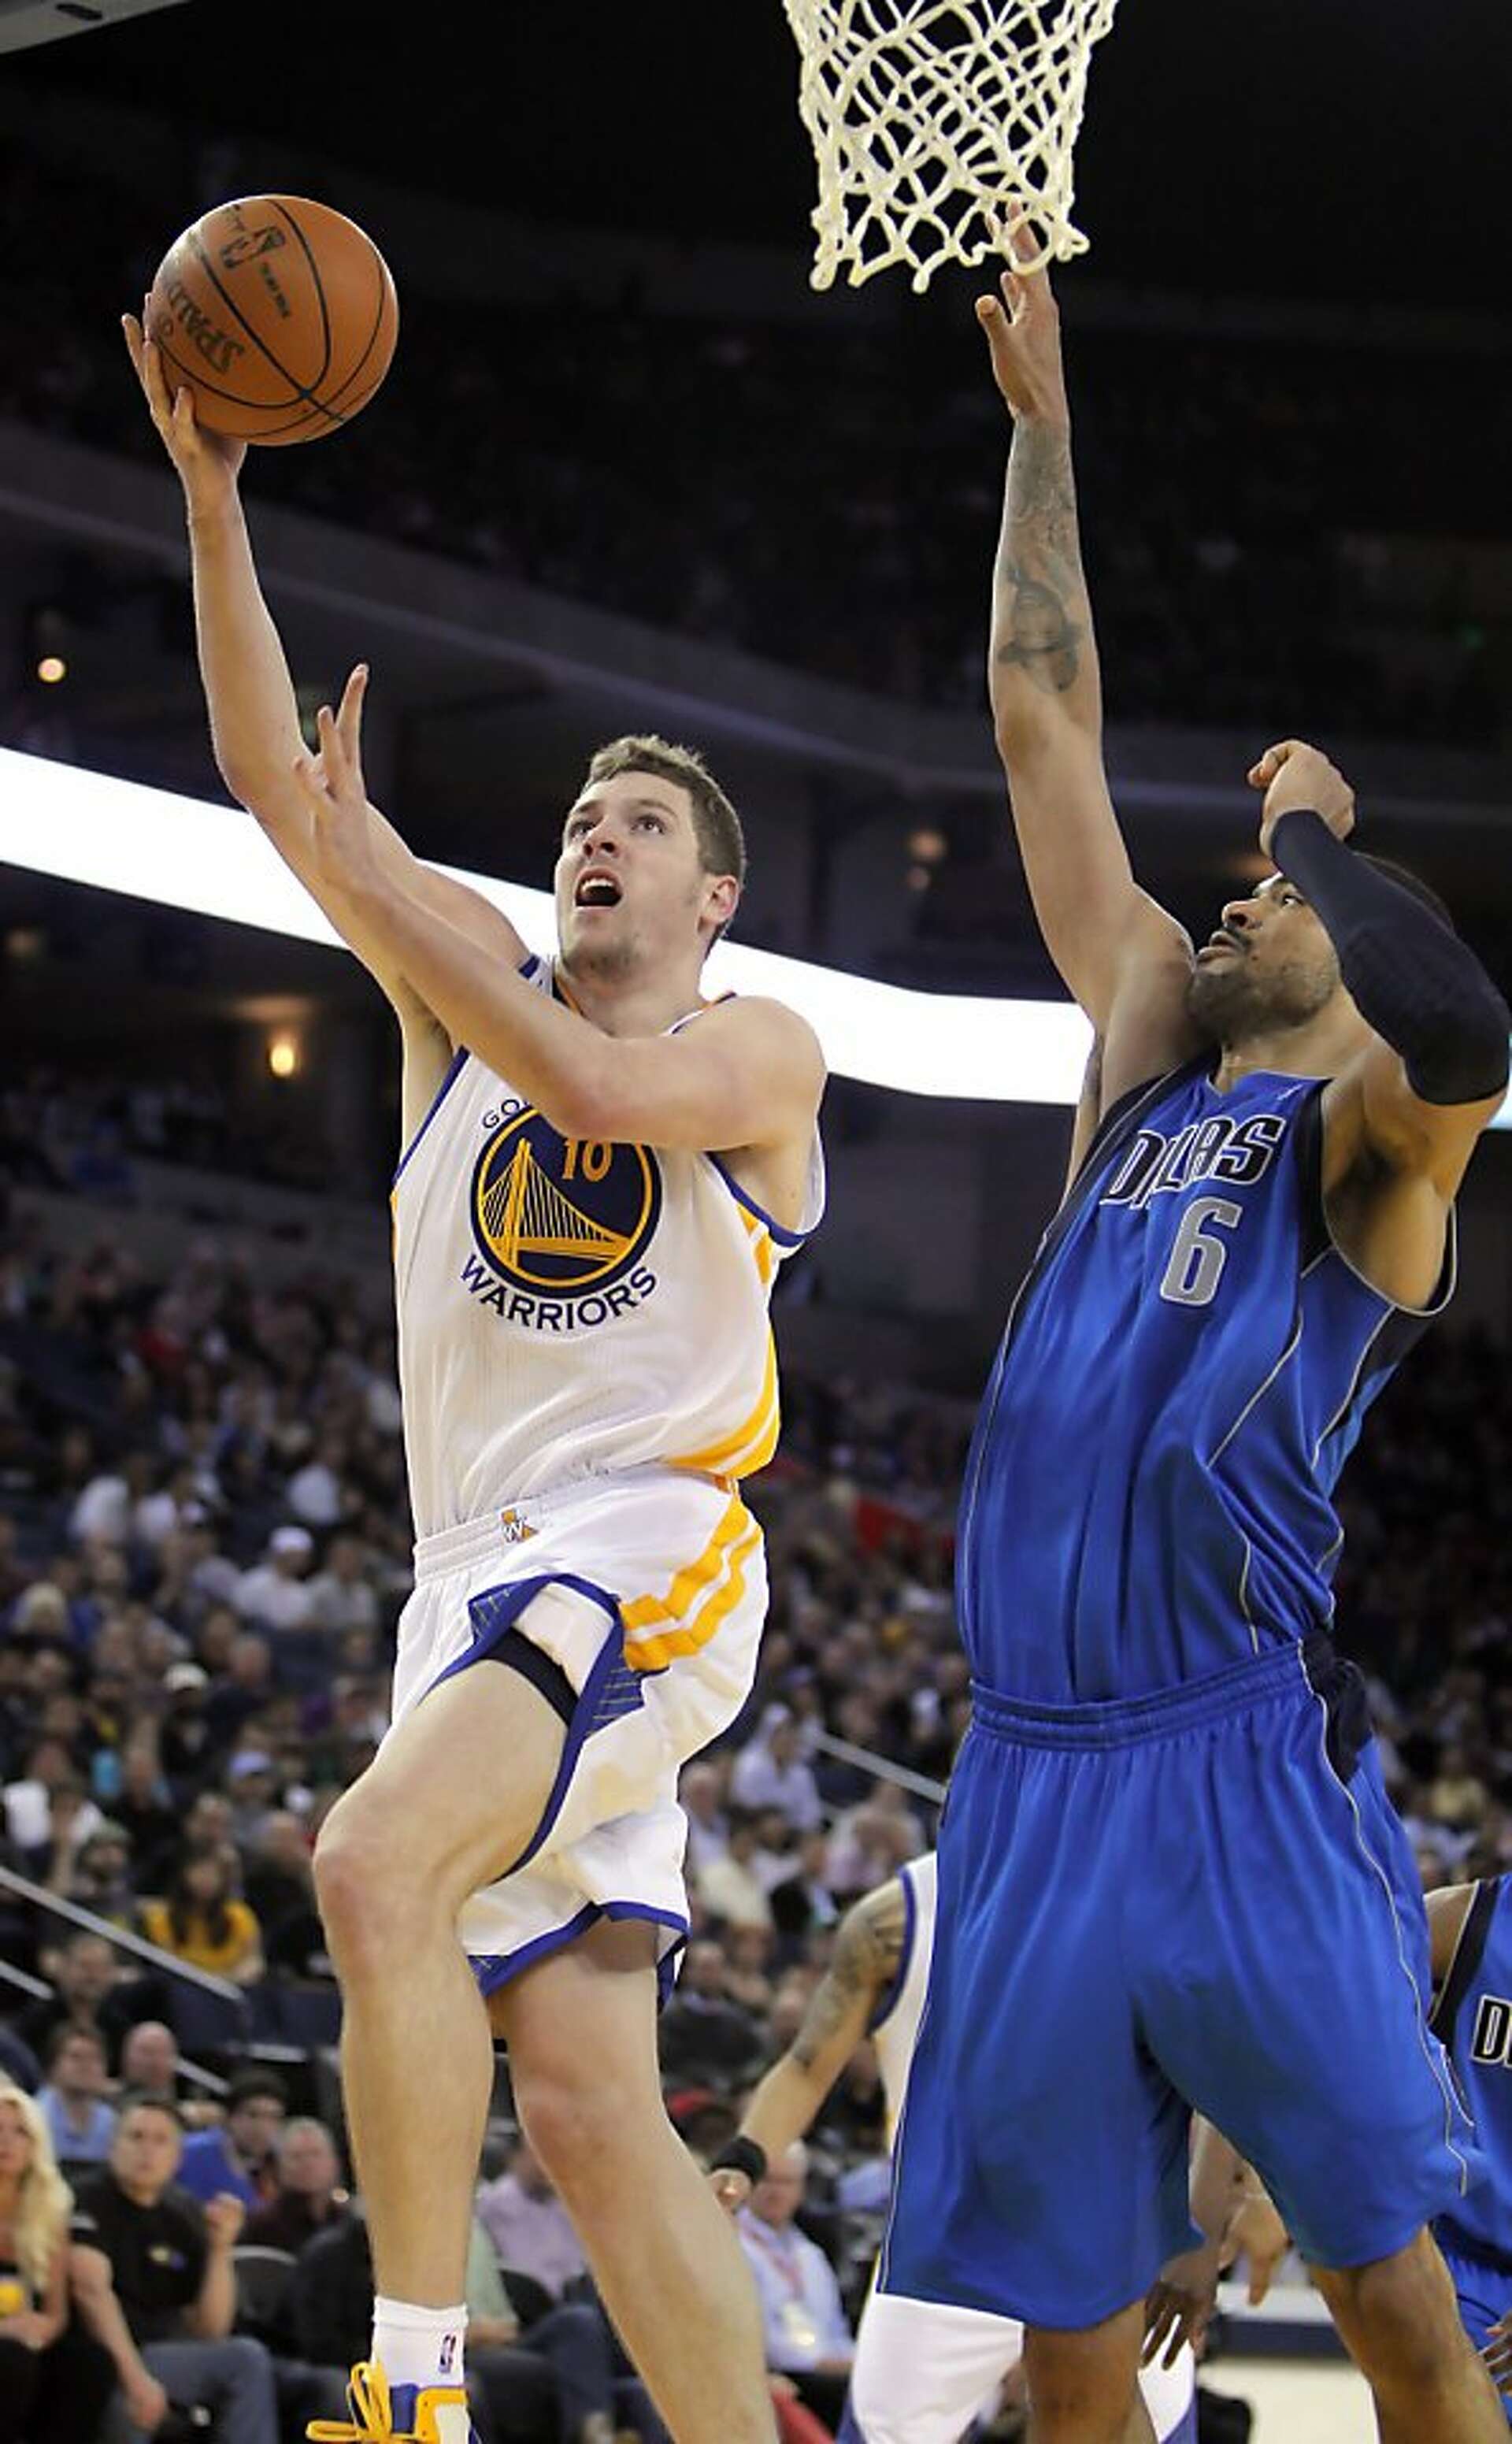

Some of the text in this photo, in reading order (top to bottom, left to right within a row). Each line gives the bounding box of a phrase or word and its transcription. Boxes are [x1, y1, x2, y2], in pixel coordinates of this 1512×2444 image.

[482, 1097, 529, 1129] GO
[561, 1137, 612, 1181] 10
[1099, 1114, 1287, 1211] DLAS
[1159, 1196, 1243, 1306] 6
[461, 1254, 657, 1331] WARRIORS
[1470, 1993, 1512, 2068] D
